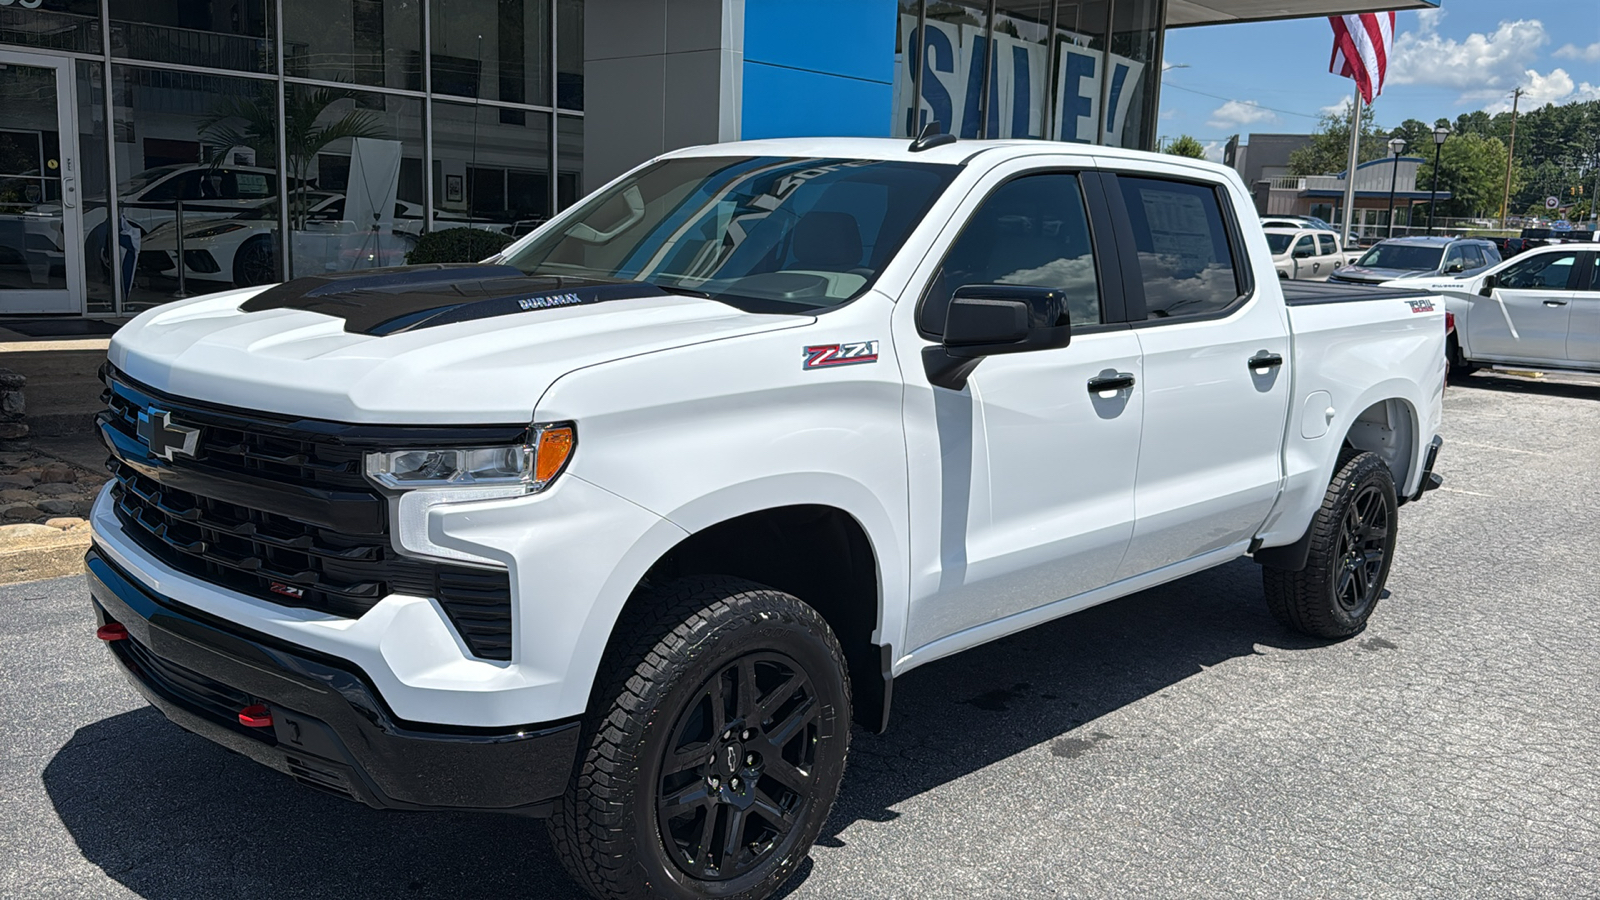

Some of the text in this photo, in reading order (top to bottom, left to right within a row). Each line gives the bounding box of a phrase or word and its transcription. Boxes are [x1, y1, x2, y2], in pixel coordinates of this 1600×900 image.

[518, 293, 582, 310] DURAMAX
[802, 340, 879, 371] Z71
[270, 582, 304, 598] Z71
